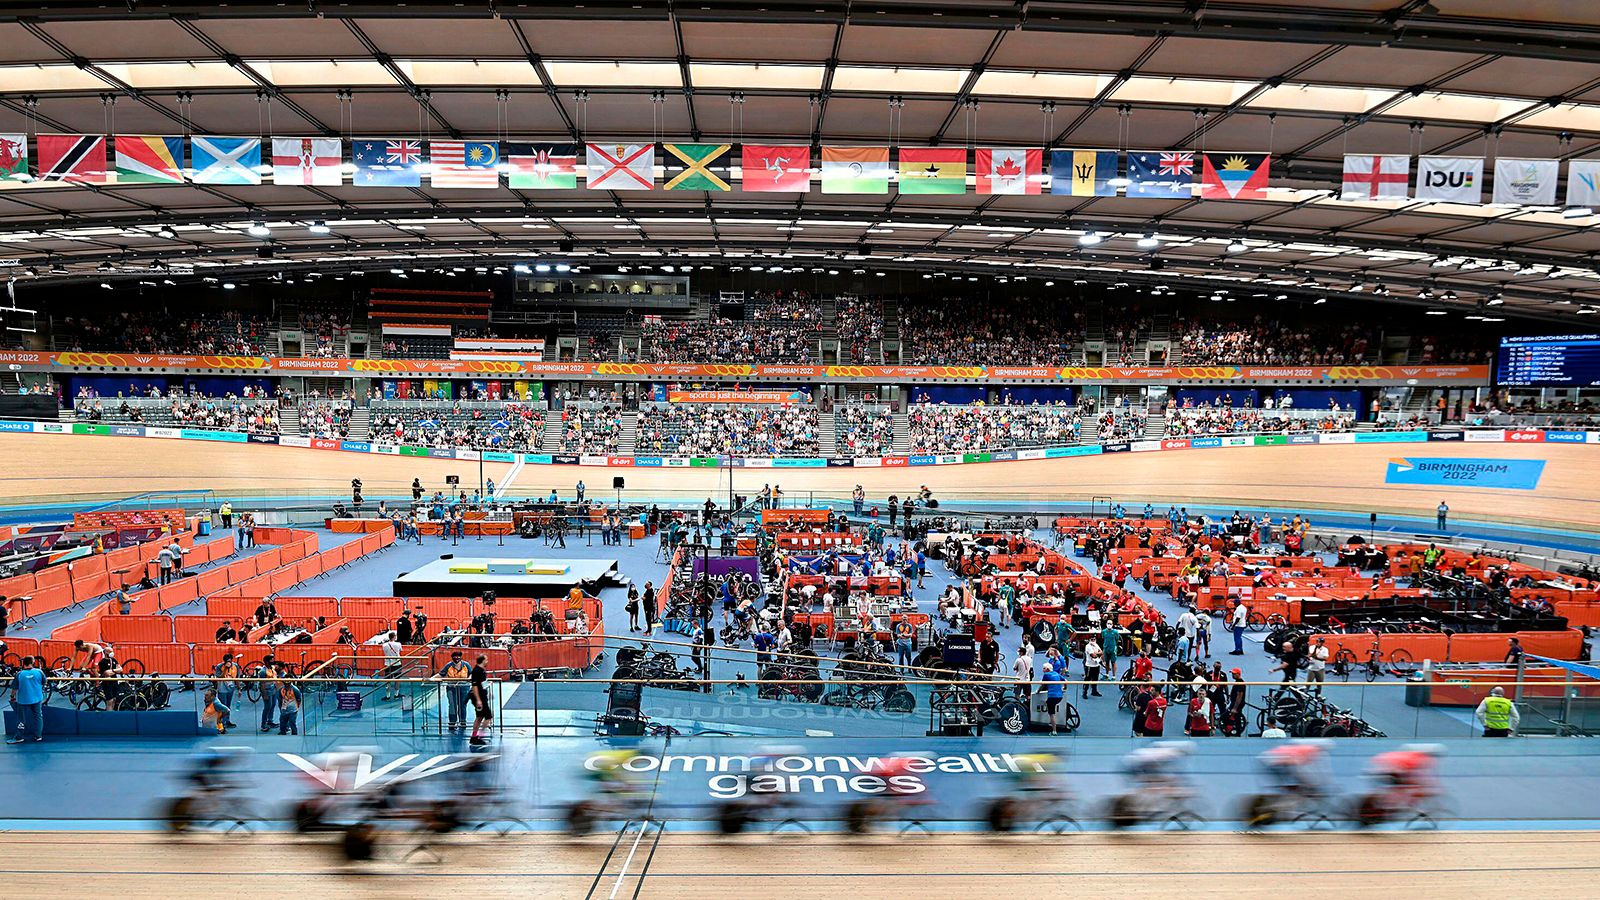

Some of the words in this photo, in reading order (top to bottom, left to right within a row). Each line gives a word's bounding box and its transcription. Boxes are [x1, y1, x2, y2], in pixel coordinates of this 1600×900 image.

[18, 354, 39, 362] 2022
[1418, 463, 1508, 474] BIRMINGHAM
[1443, 471, 1477, 480] 2022
[583, 752, 1047, 774] commonwealth
[708, 772, 927, 799] games
